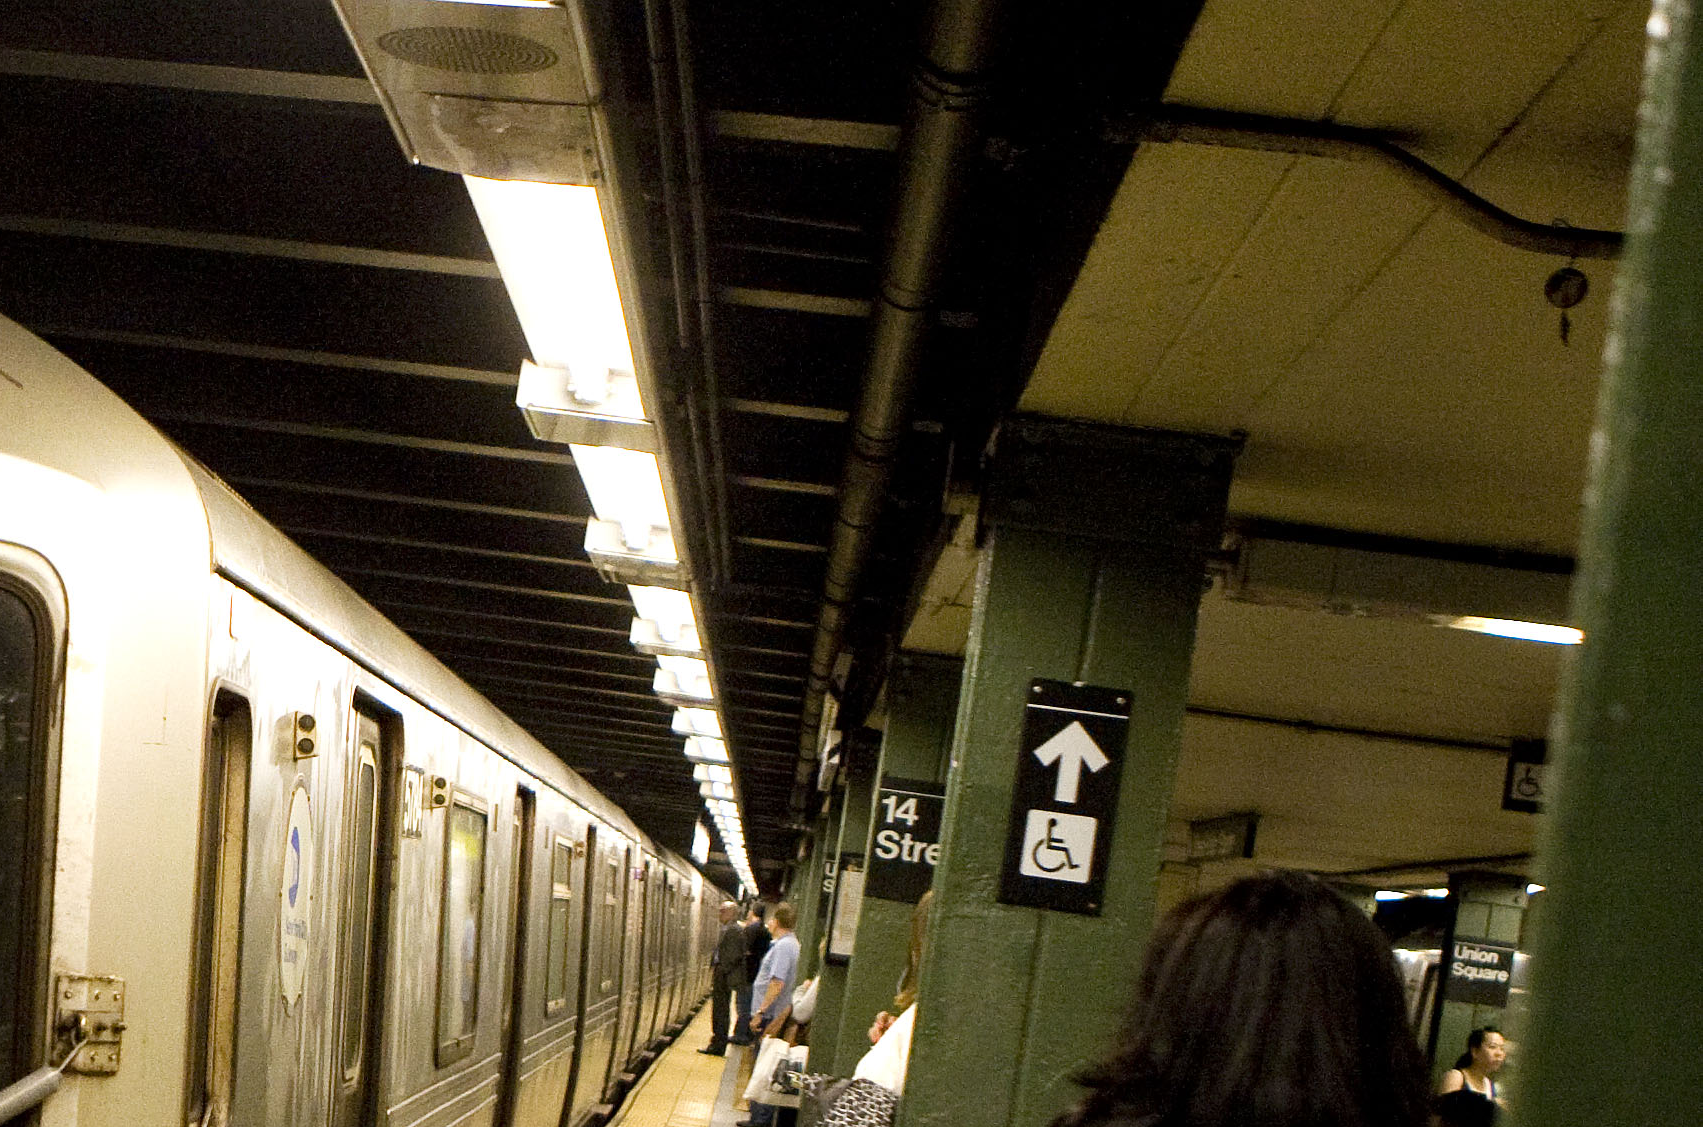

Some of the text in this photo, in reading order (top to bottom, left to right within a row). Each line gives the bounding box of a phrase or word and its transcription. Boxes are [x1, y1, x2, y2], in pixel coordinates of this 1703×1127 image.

[882, 795, 919, 825] 14
[1454, 944, 1499, 963] Union
[1452, 962, 1509, 982] Square
